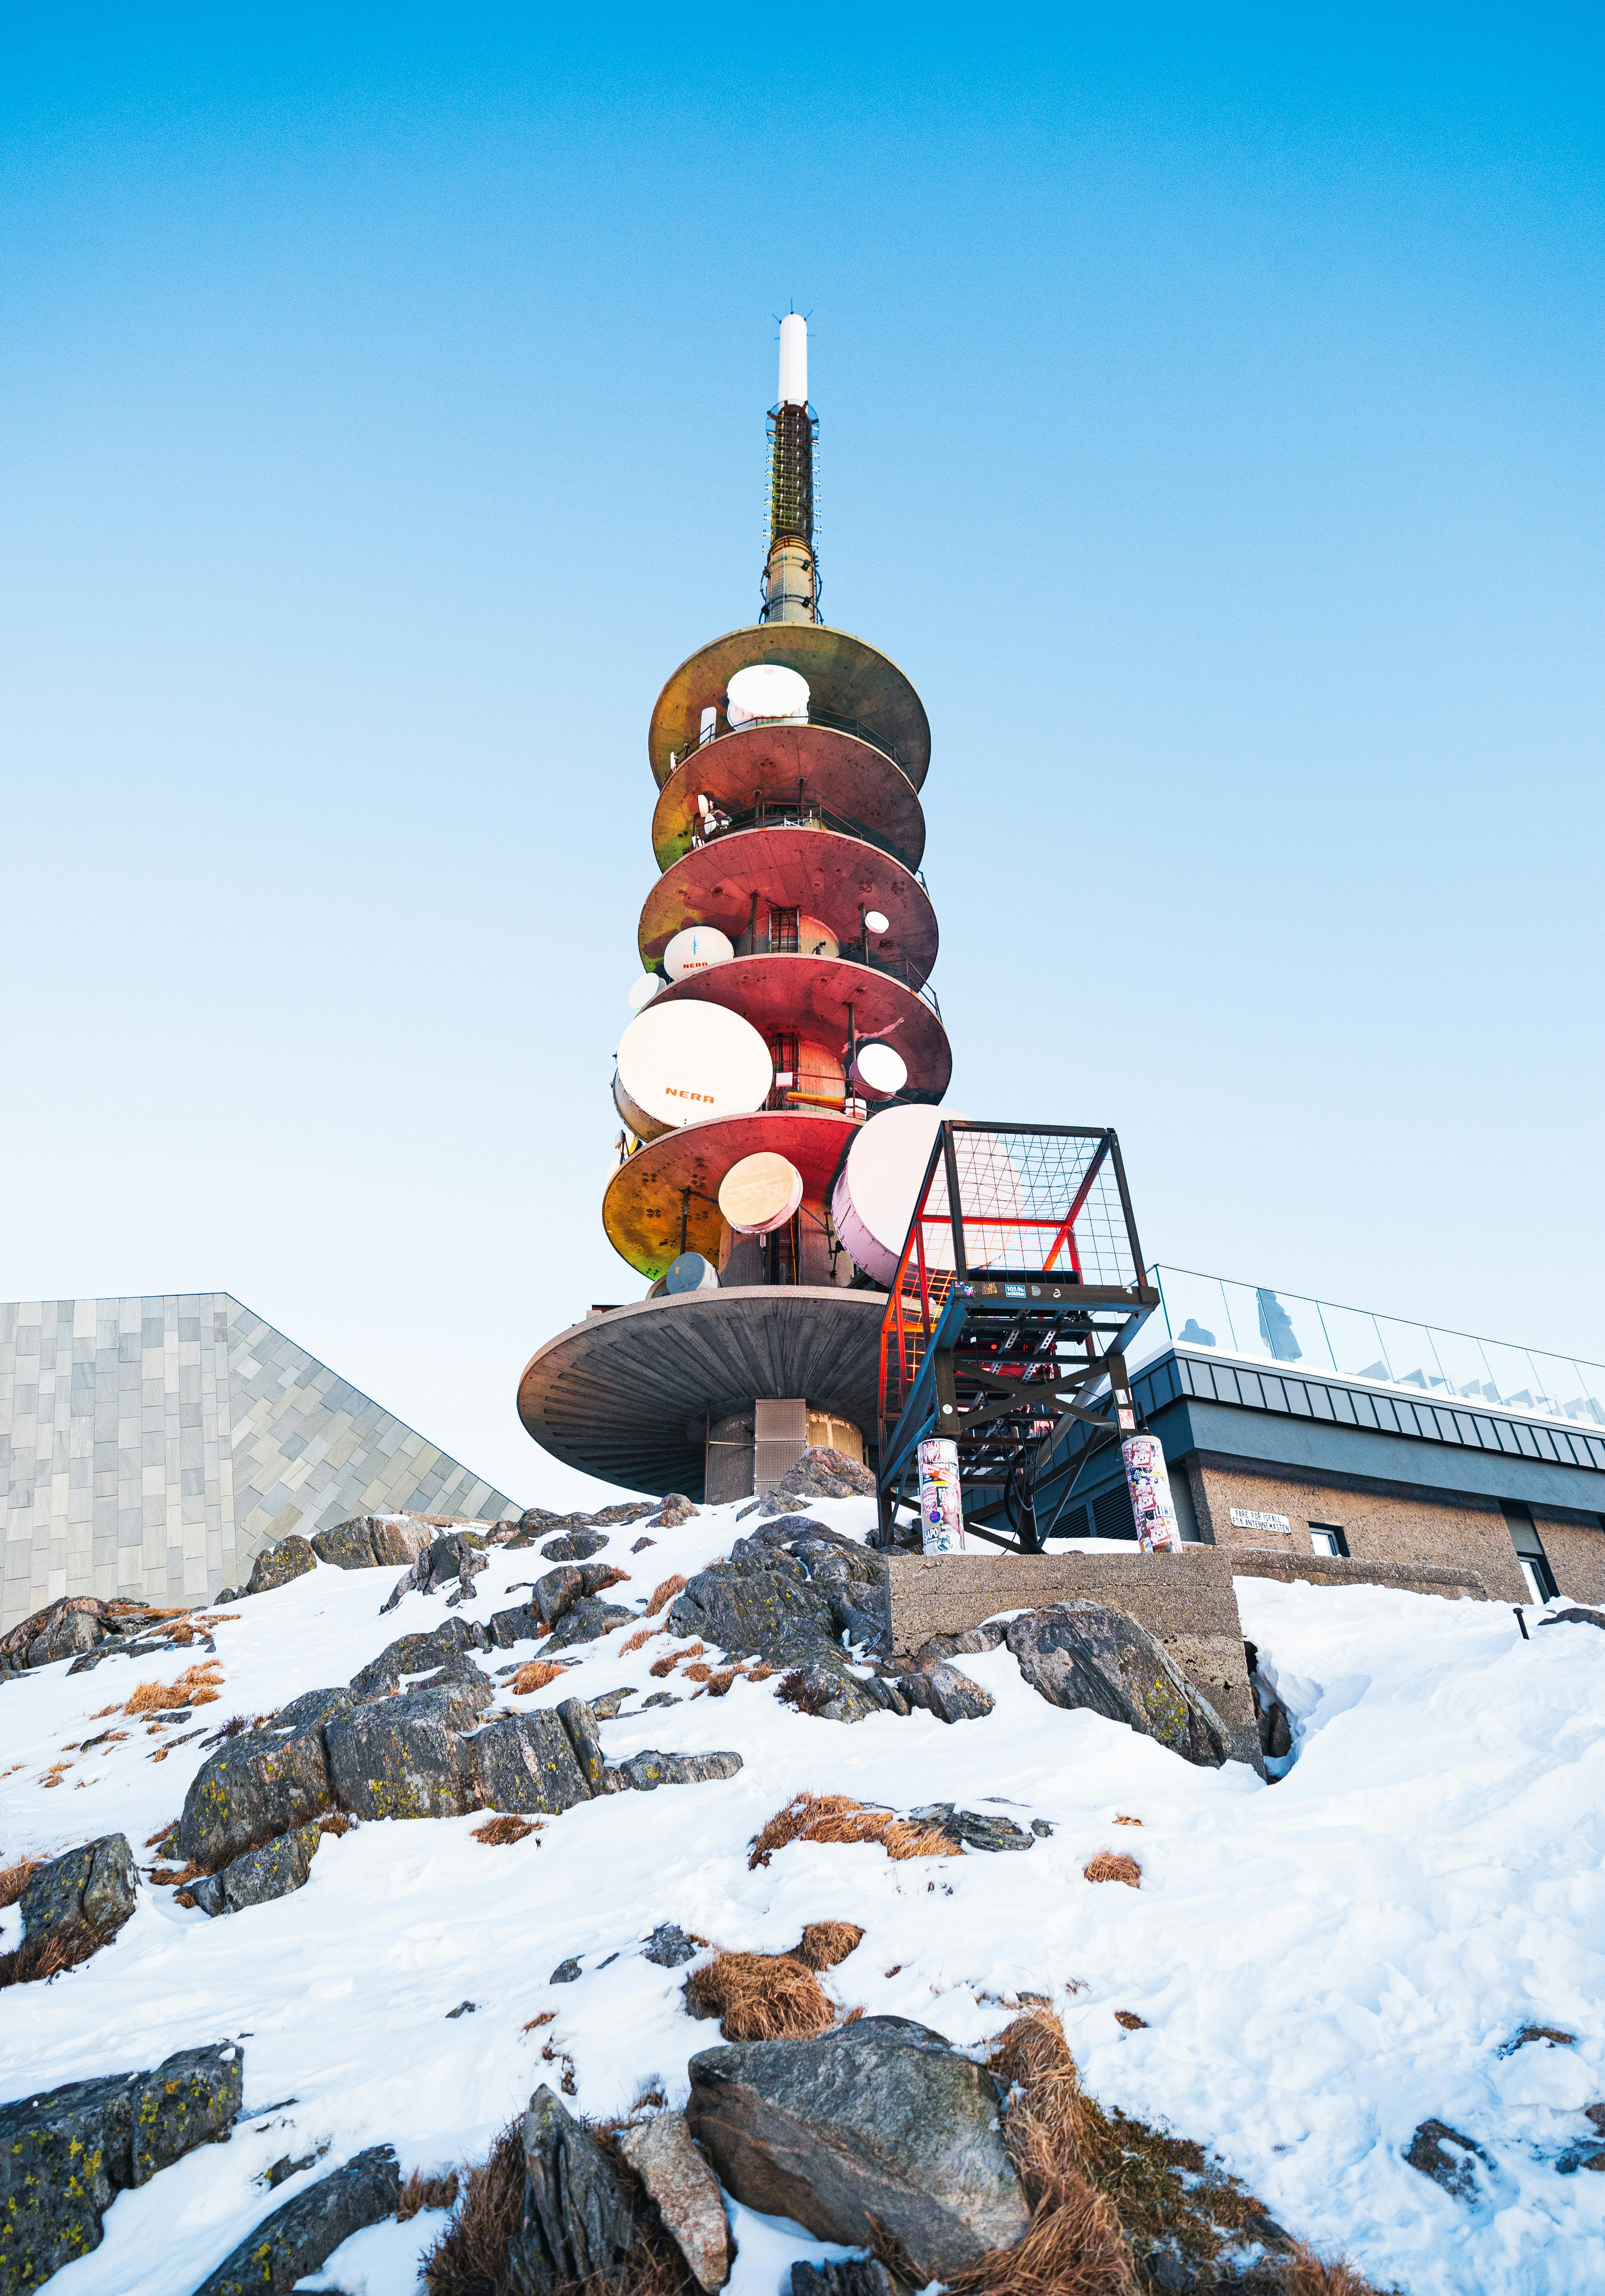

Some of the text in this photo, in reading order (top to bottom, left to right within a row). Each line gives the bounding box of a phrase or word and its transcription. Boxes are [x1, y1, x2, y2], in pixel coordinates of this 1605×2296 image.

[666, 1088, 714, 1104] NERA
[1135, 1487, 1151, 1496] ACAB
[1236, 1510, 1281, 1523] FARE FOR ISFALL
[1233, 1517, 1290, 1532] FRA ANTENNEMASTEN
[924, 1528, 938, 1544] SAPO
